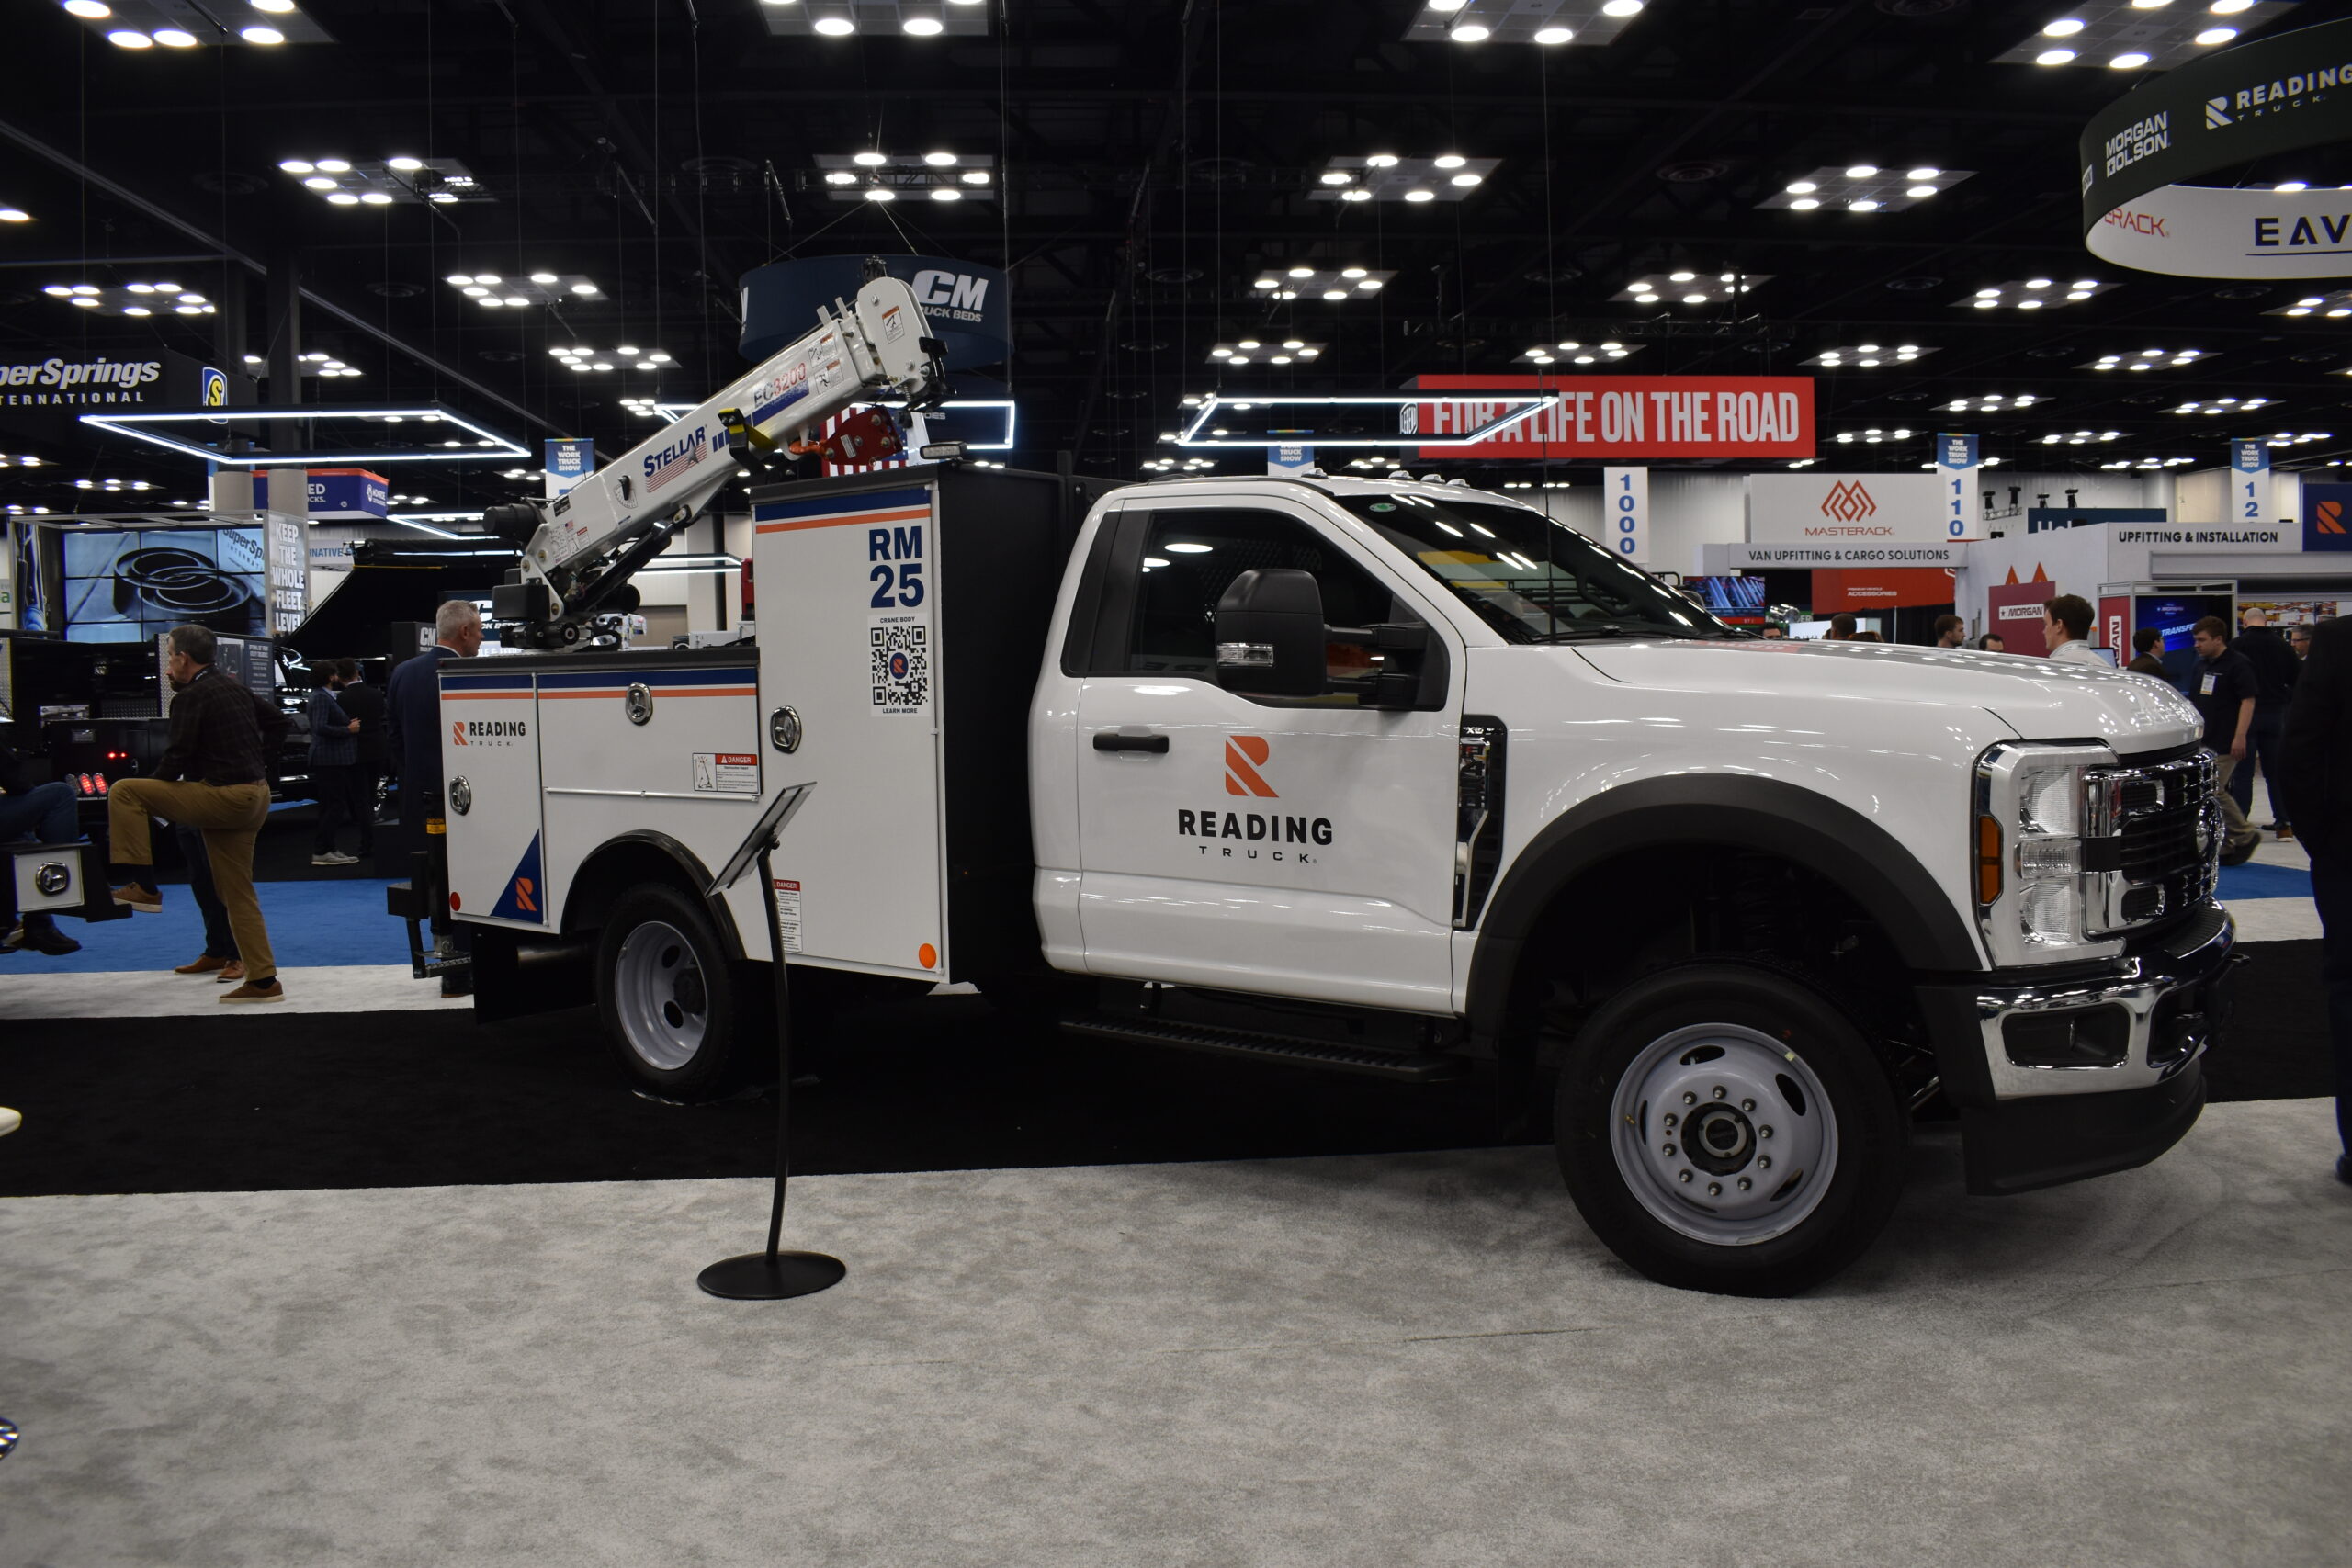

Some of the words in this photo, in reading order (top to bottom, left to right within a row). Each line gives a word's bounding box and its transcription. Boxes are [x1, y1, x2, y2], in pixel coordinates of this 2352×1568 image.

[2236, 64, 2352, 109] READING
[2238, 95, 2322, 121] TRUCK
[2106, 110, 2167, 159] MORGAN
[2255, 214, 2352, 247] EAV
[911, 269, 989, 312] CM
[922, 306, 951, 319] UCK
[952, 309, 983, 323] BEDS
[753, 362, 807, 407] EC3200
[1530, 391, 1594, 443] LIFE
[1601, 391, 1645, 443] ON
[1651, 391, 1718, 443] THE
[1724, 391, 1800, 443] ROAD
[643, 425, 707, 478] STELLAR
[1618, 473, 1636, 555] 1000
[1949, 479, 1964, 536] 110
[2245, 481, 2259, 523] 12
[276, 522, 299, 543] KEEP
[868, 525, 922, 562] RM
[1804, 526, 1893, 536] MASTERACK
[2119, 531, 2182, 544] UPFITTING
[2185, 531, 2193, 544] &
[2196, 531, 2278, 544] INSTALLATION
[279, 545, 297, 566] THE
[1748, 550, 1772, 561] VAN
[1774, 550, 1832, 561] UPFITTING
[1834, 550, 1842, 561] &
[1844, 550, 1885, 561] CARGO
[1888, 549, 1950, 561] SOLUTIONS
[272, 567, 305, 589] WHOLE
[869, 563, 925, 609] 25
[276, 589, 302, 611] FLEET
[2008, 606, 2042, 617] MORGAN
[420, 627, 436, 647] CM
[469, 721, 526, 737] READING
[1178, 808, 1332, 846] READING
[1198, 844, 1309, 863] TRUCK
[776, 881, 797, 889] DANGER
